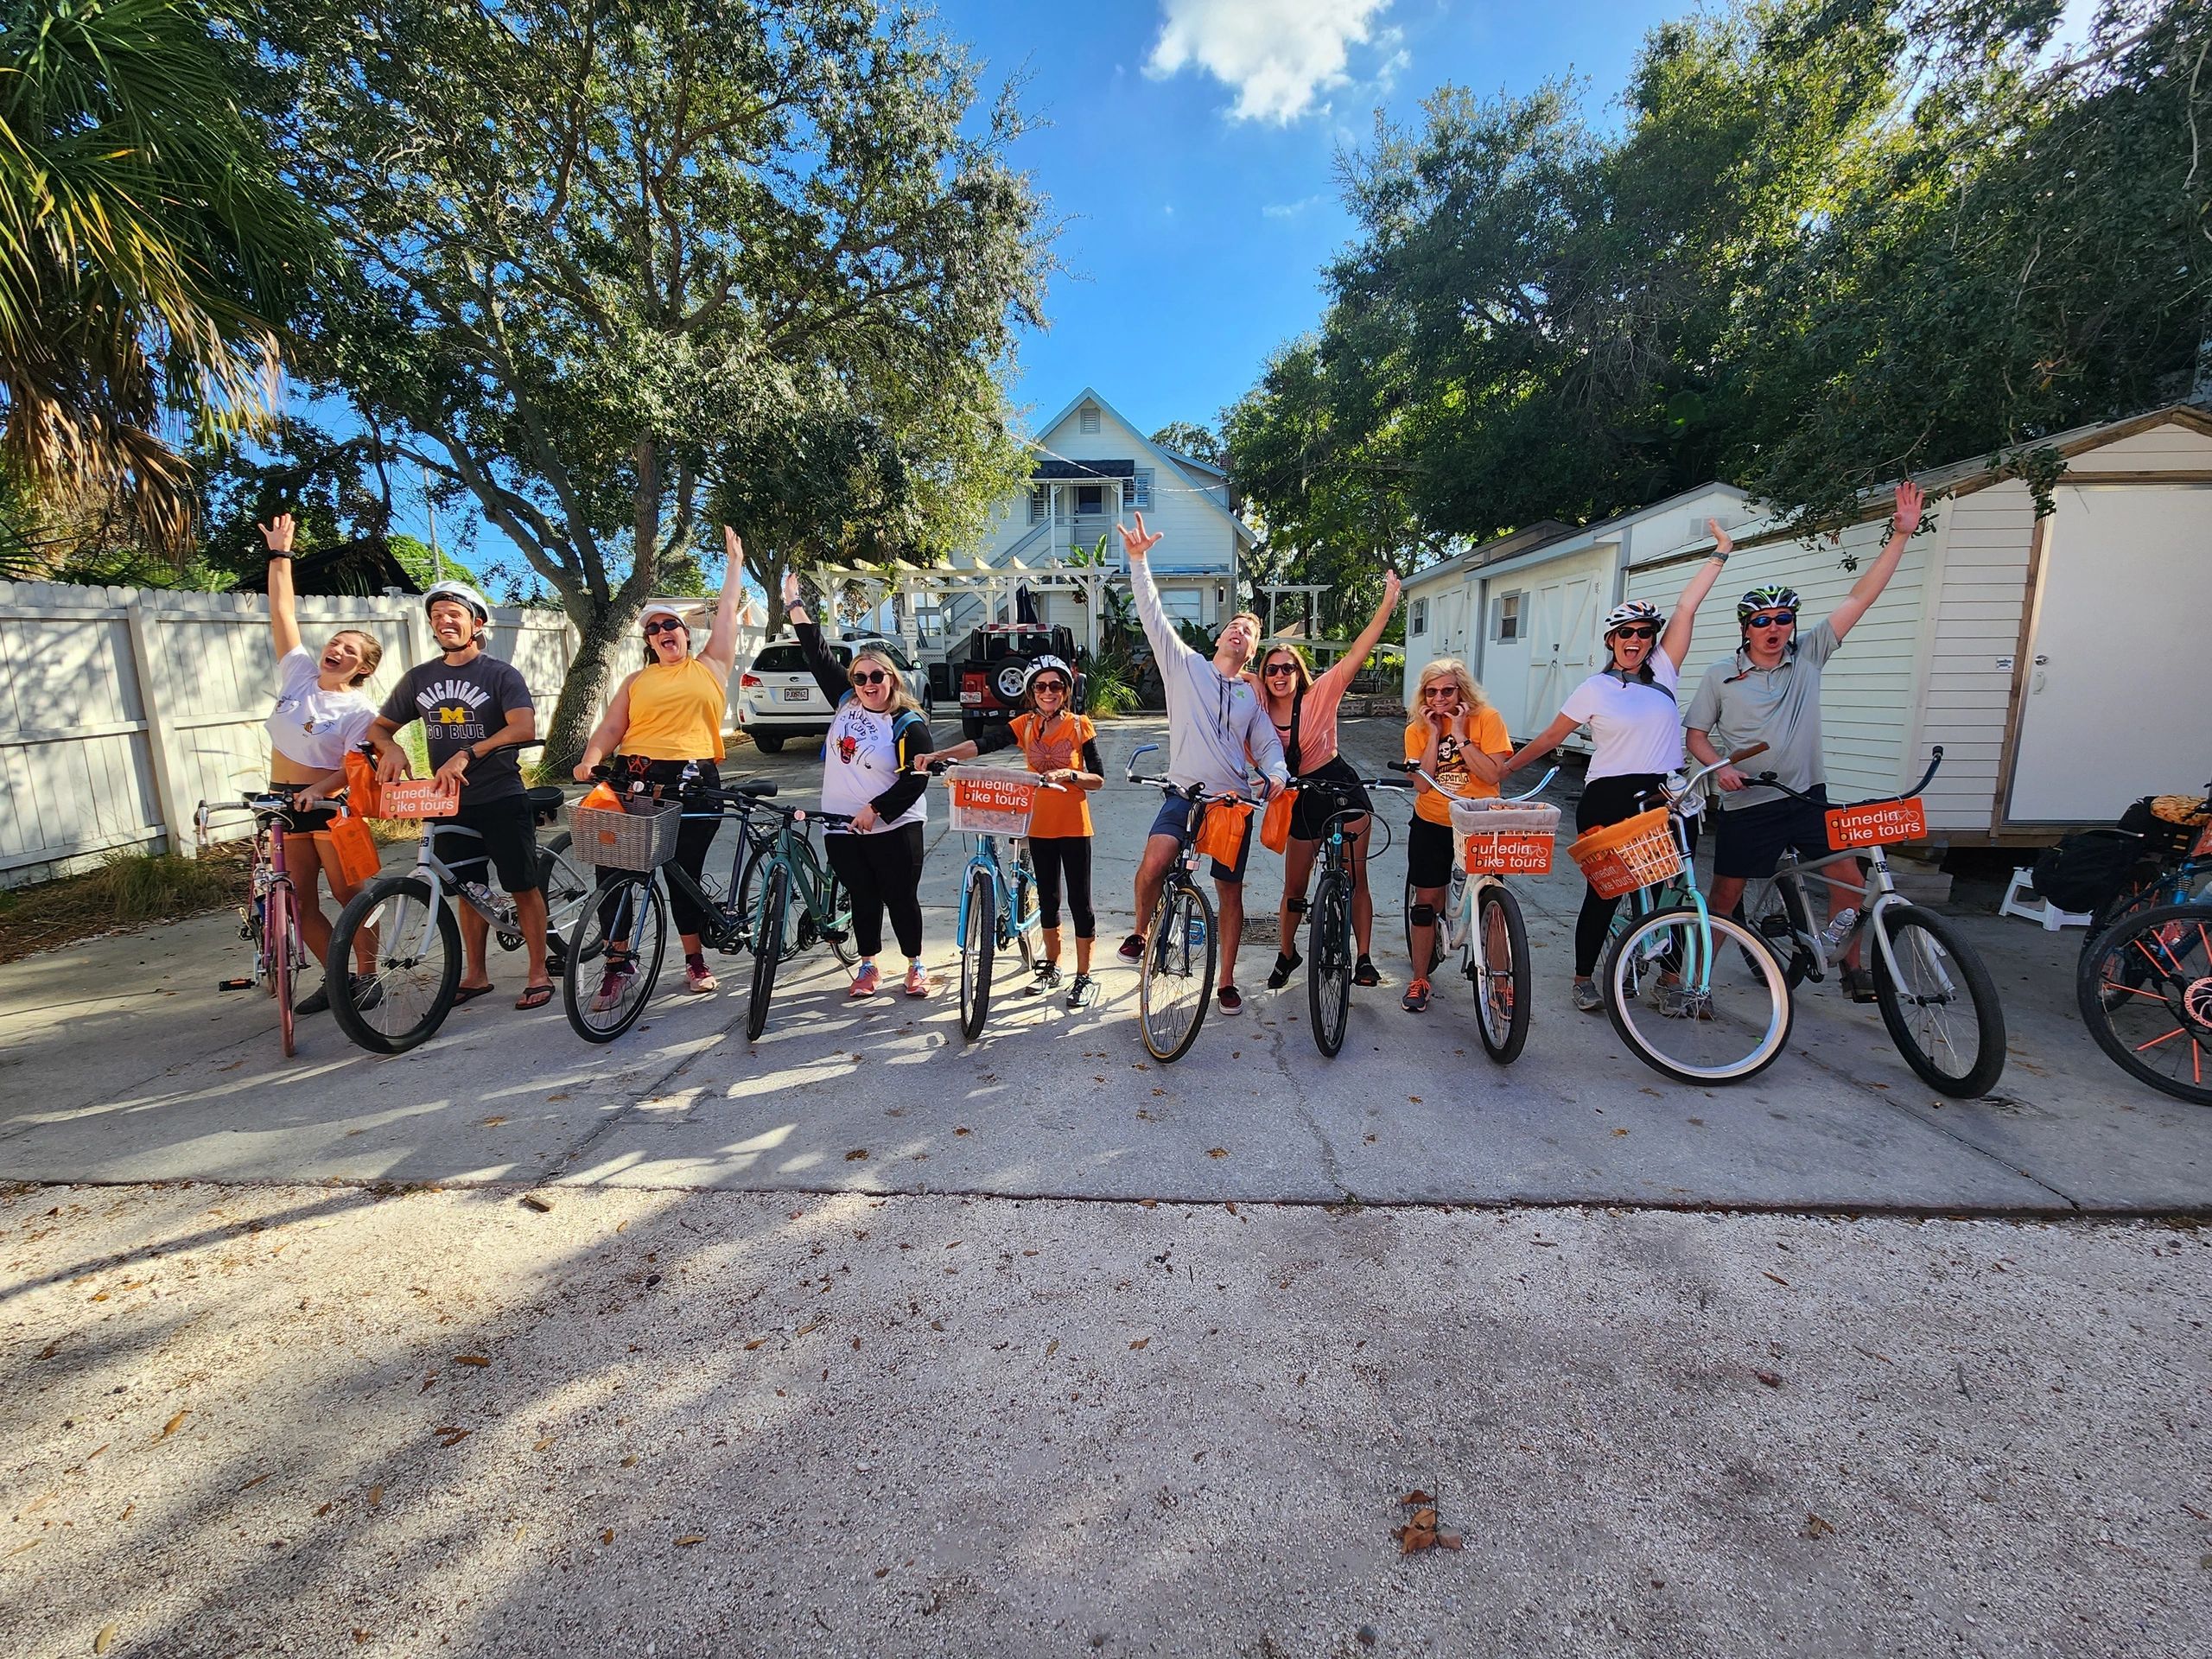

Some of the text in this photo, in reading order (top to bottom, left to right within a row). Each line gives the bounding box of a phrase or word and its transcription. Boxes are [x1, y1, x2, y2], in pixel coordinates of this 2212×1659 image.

[416, 679, 491, 709] MICHIGAN
[439, 707, 465, 723] M
[427, 724, 486, 740] GO BLUE
[420, 799, 454, 811] tours
[963, 790, 1028, 807] bike tours
[1878, 822, 1921, 837] tours
[1475, 855, 1547, 868] bike tours
[1611, 874, 1634, 887] tours
